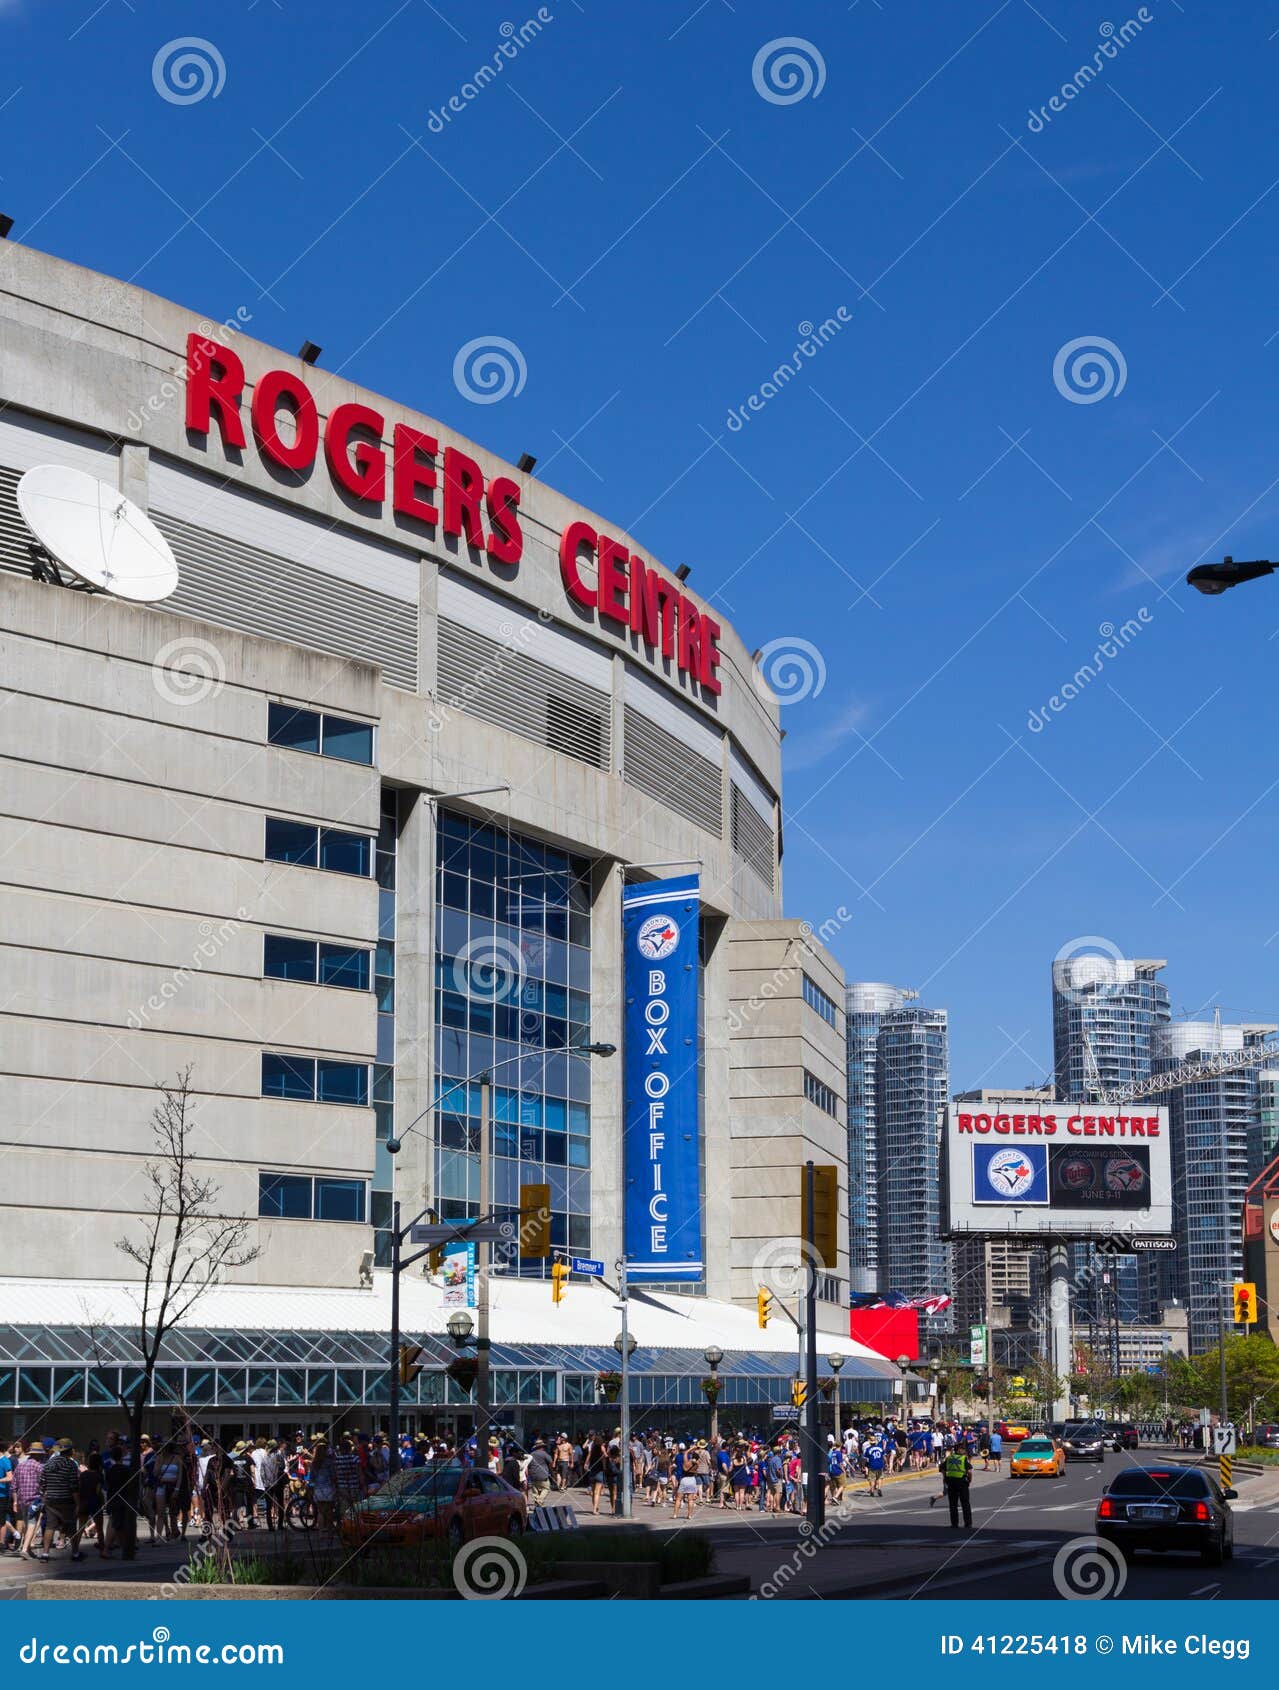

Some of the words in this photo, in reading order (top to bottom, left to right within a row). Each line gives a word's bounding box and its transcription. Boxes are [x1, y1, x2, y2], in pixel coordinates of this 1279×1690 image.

[186, 333, 524, 565] ROGERS
[559, 521, 722, 696] CENTRE
[641, 918, 668, 935] TORONTO
[646, 970, 669, 1056] BOX
[958, 1113, 1057, 1135] ROGERS
[1067, 1115, 1160, 1137] CENTRE
[645, 1071, 669, 1253] OFFICE
[993, 1153, 1022, 1167] TORONTO
[993, 1176, 1009, 1193] BLUE
[1080, 1190, 1104, 1200] JUNE
[1105, 1190, 1121, 1200] 9-11
[1134, 1239, 1174, 1249] PATTISON
[576, 1260, 597, 1272] Bremner
